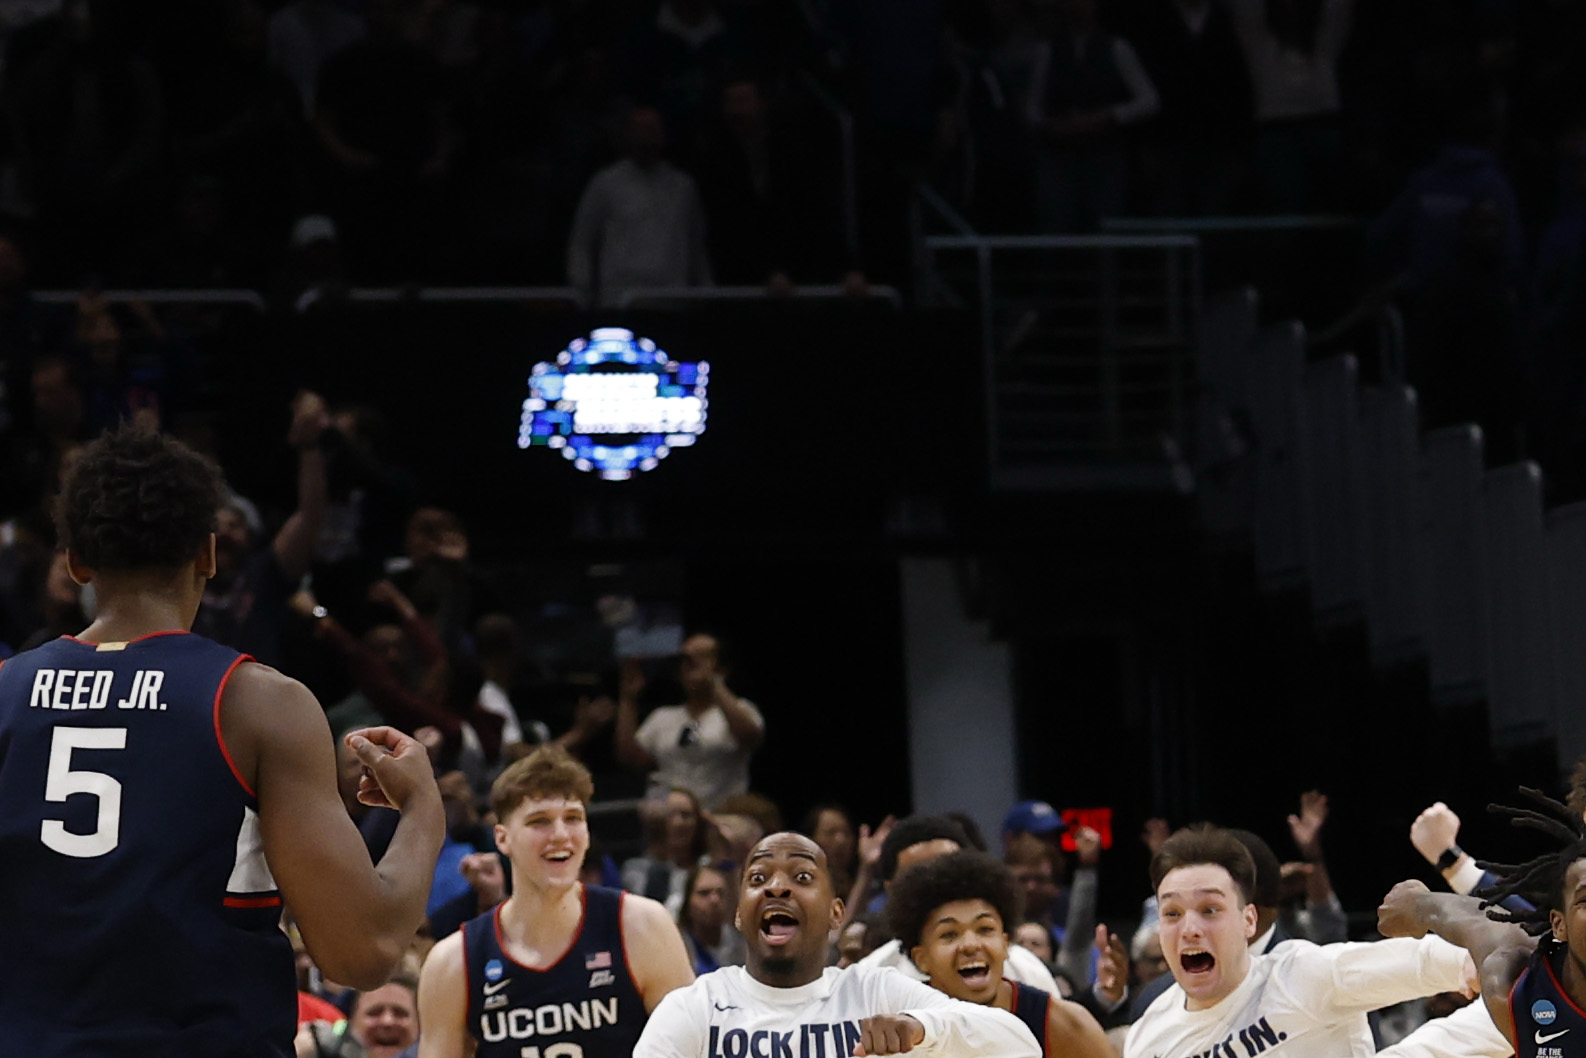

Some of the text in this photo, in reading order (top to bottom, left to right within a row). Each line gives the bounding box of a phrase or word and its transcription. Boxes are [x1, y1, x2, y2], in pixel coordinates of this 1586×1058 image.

[30, 669, 167, 711] REED JR.
[40, 726, 127, 858] 5
[481, 997, 618, 1042] UCONN
[1239, 1016, 1287, 1058] IN.
[1538, 1047, 1562, 1056] BE THE
